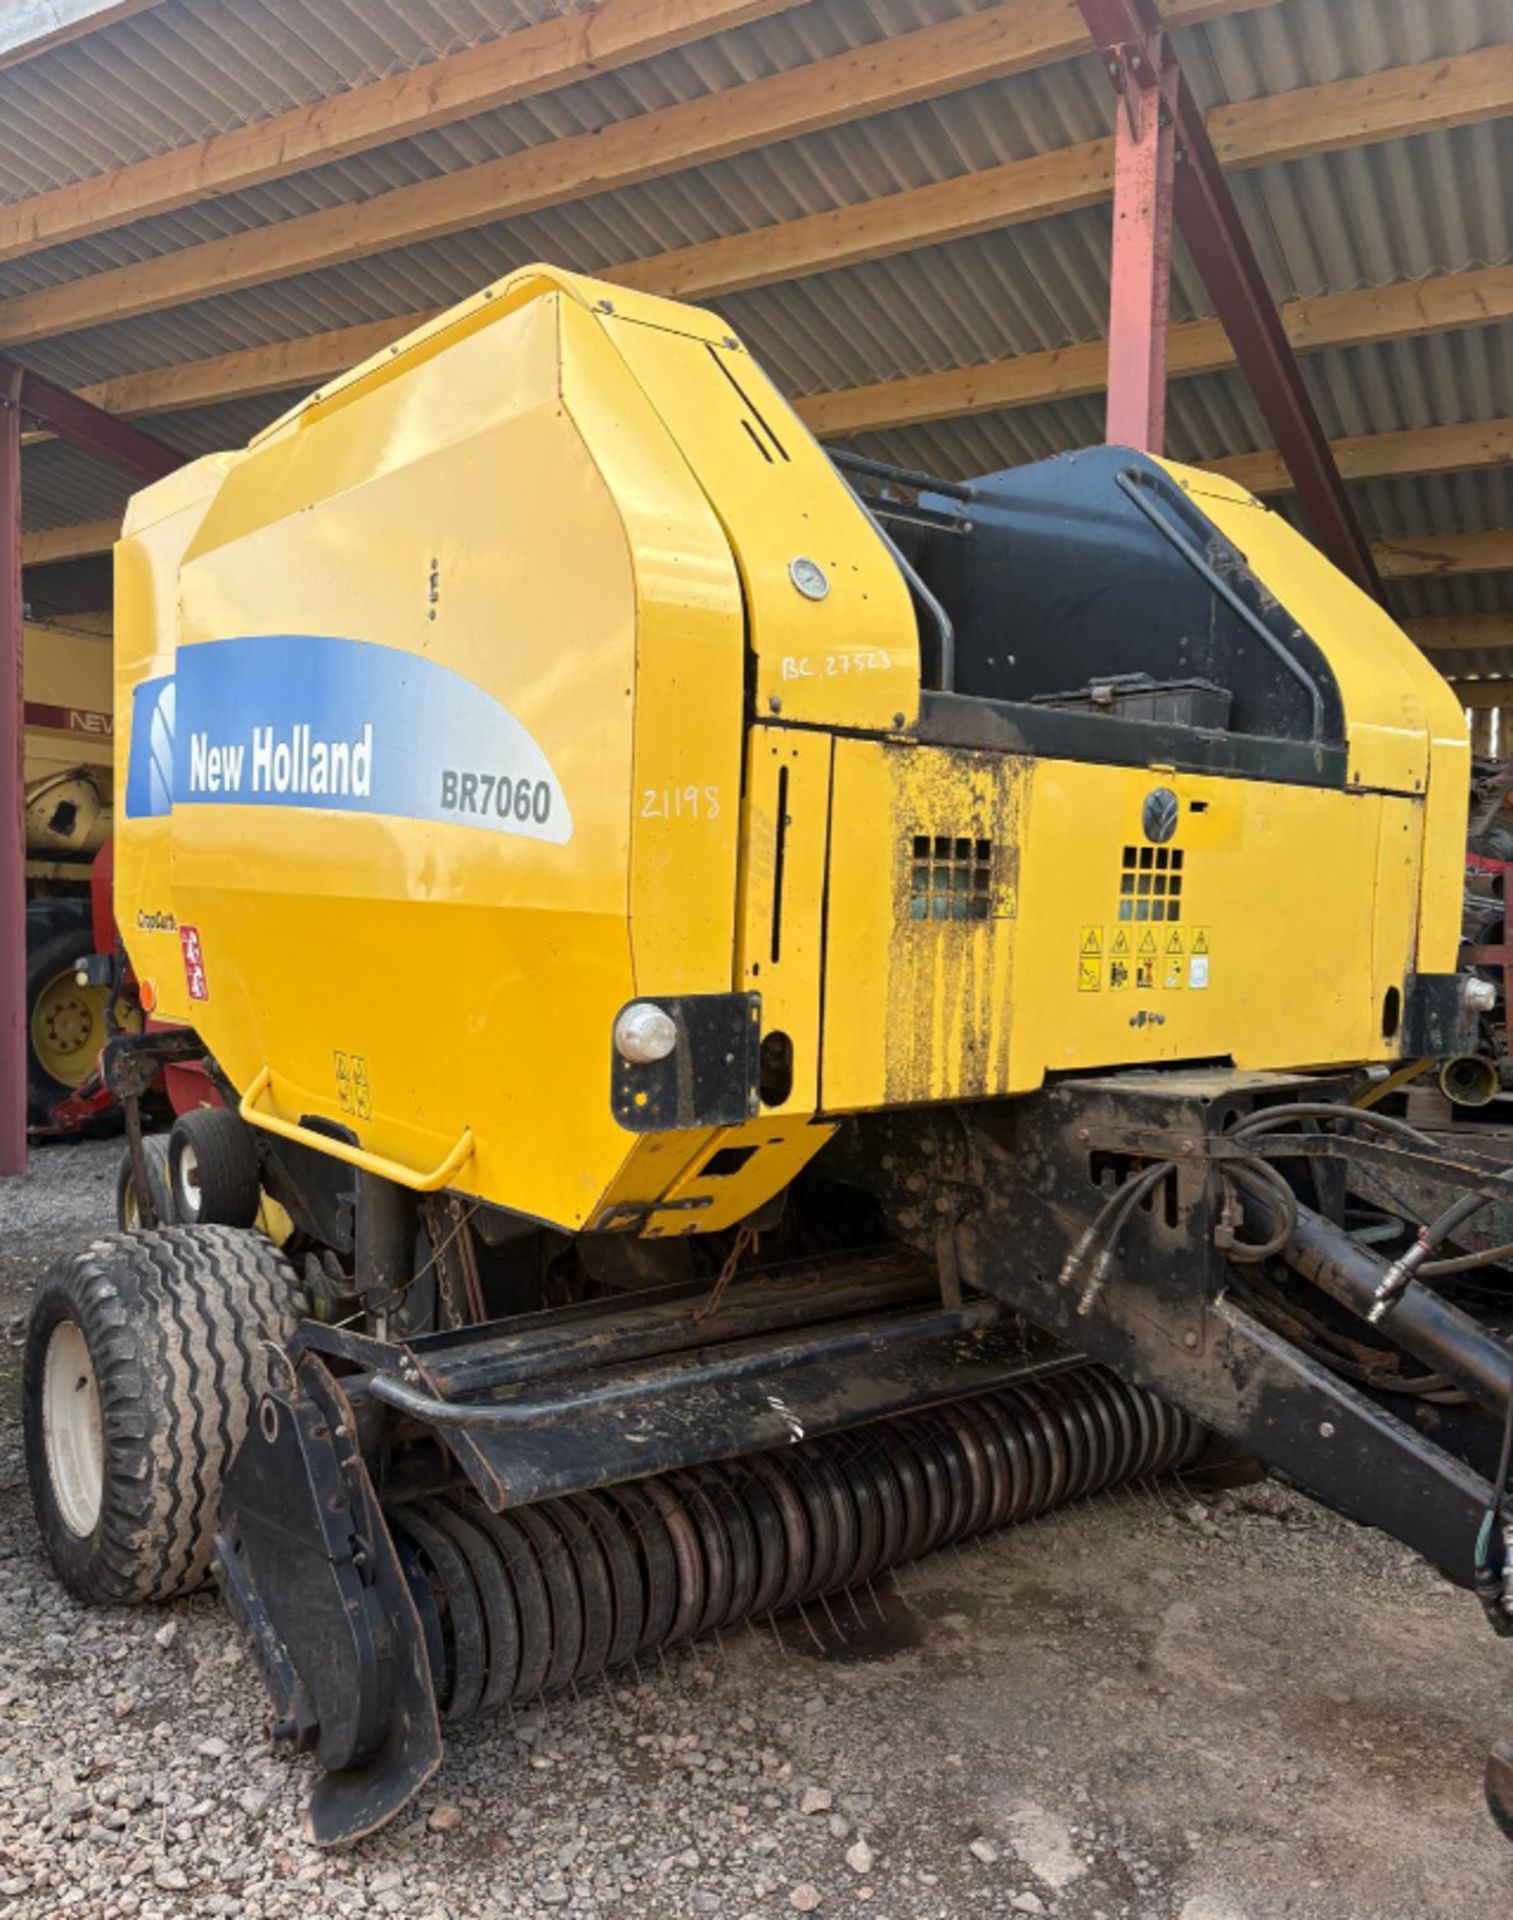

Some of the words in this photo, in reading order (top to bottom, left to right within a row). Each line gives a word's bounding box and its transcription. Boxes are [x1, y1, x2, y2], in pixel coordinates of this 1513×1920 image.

[190, 732, 244, 792] New
[252, 723, 373, 797] Holland
[440, 770, 551, 824] BR7060
